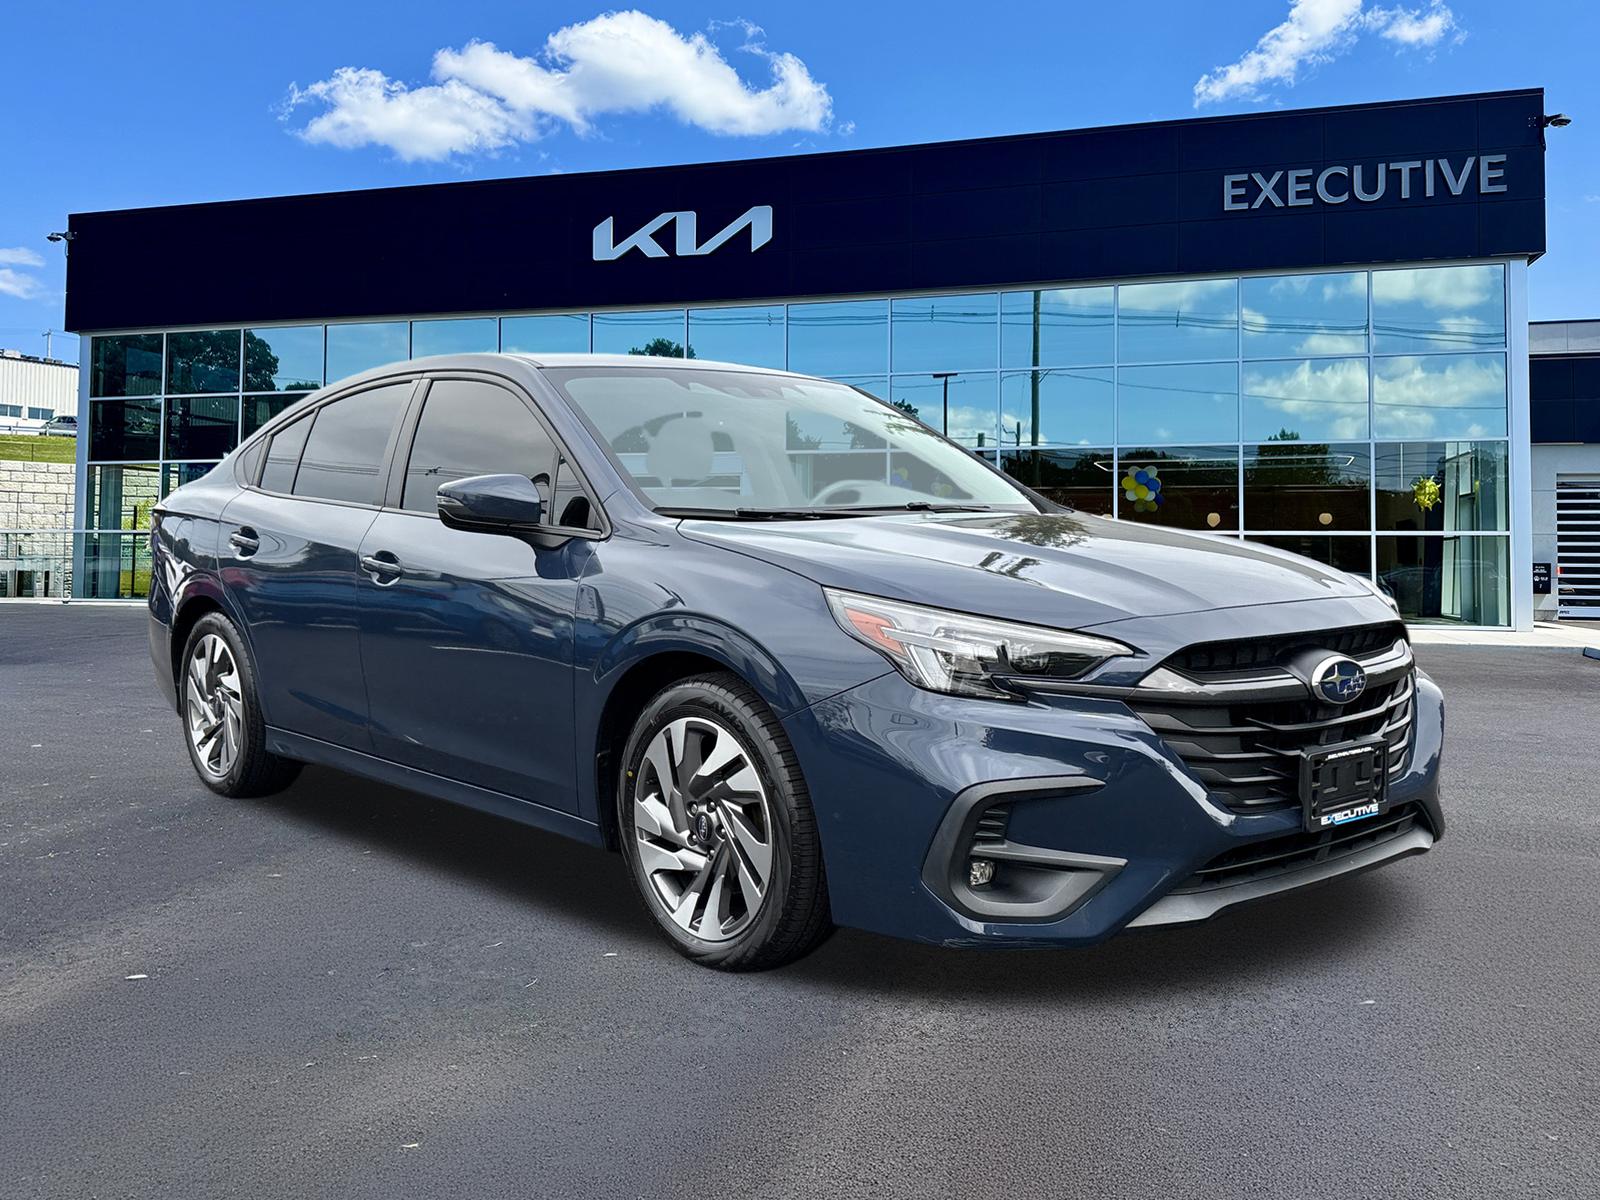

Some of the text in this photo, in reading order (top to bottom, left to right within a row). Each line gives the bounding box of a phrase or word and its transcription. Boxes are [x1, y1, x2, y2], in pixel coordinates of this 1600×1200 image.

[1223, 154, 1508, 211] EXECUTIVE
[592, 205, 773, 262] KIA
[1320, 803, 1379, 826] EXECUTIVE
